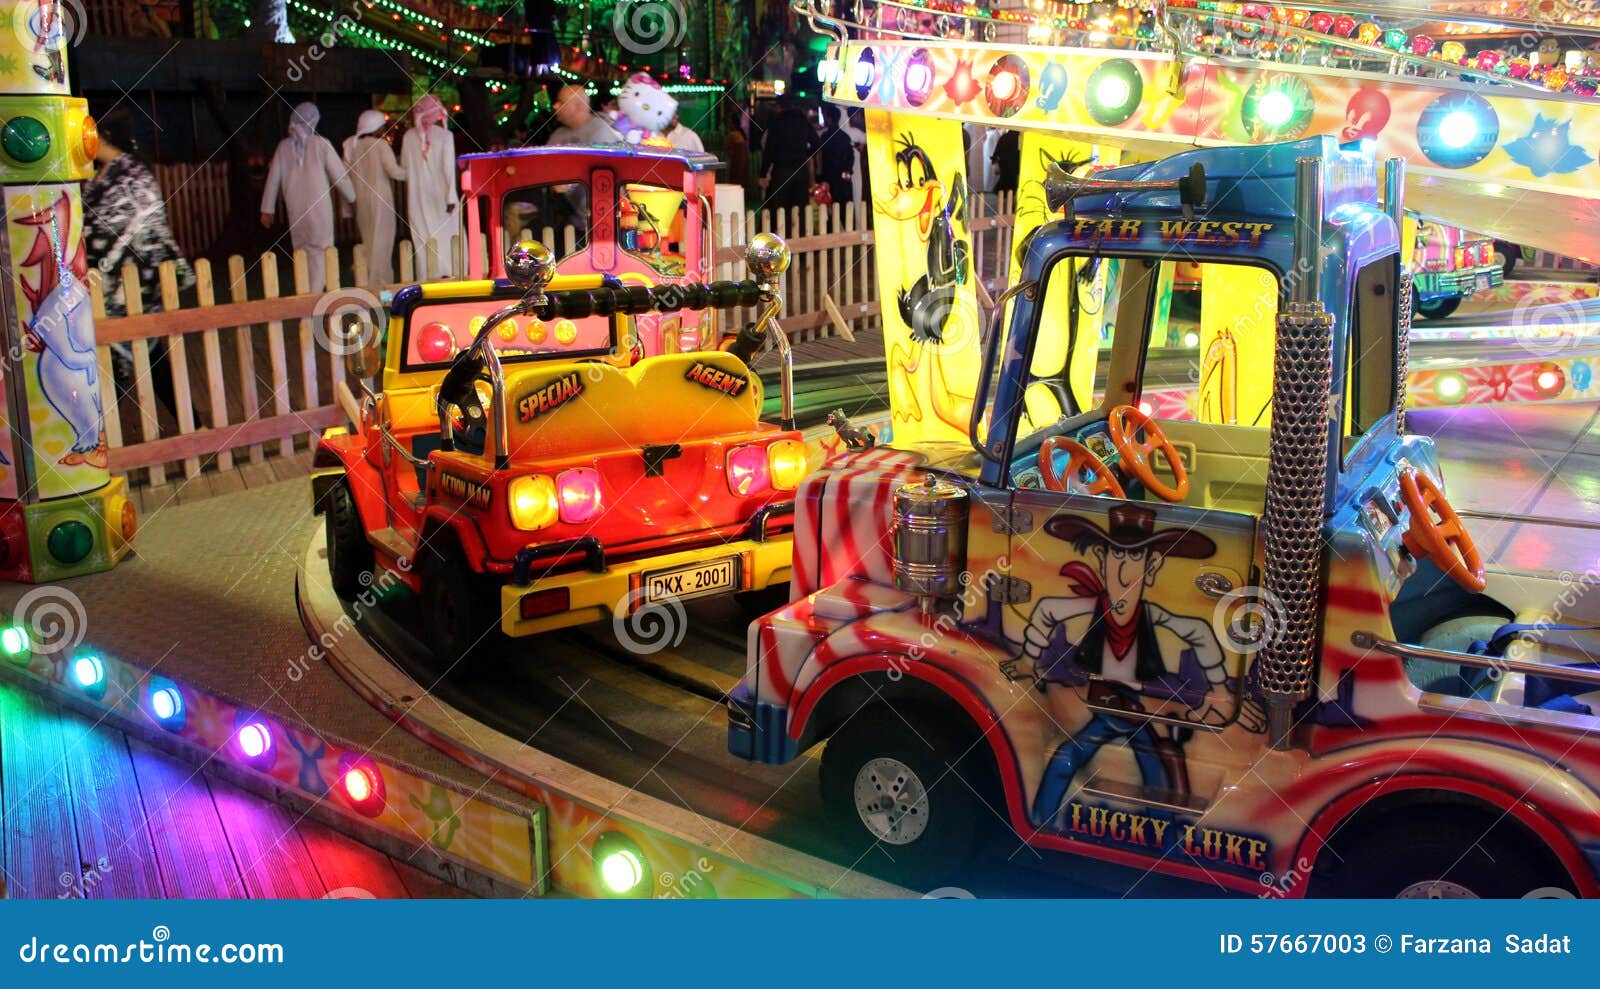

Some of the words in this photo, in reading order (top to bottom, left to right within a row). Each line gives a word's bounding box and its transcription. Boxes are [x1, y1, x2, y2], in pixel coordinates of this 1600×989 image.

[1071, 218, 1143, 242] FAR
[1160, 220, 1273, 248] WEST
[519, 373, 583, 422] SPECIAL
[687, 363, 746, 395] AGENT
[441, 472, 466, 498] ACTION
[467, 482, 490, 509] MAN
[654, 575, 683, 597] DKX
[695, 567, 726, 588] 2001
[1071, 803, 1170, 849] LUCKY
[1184, 824, 1267, 872] LUKE
